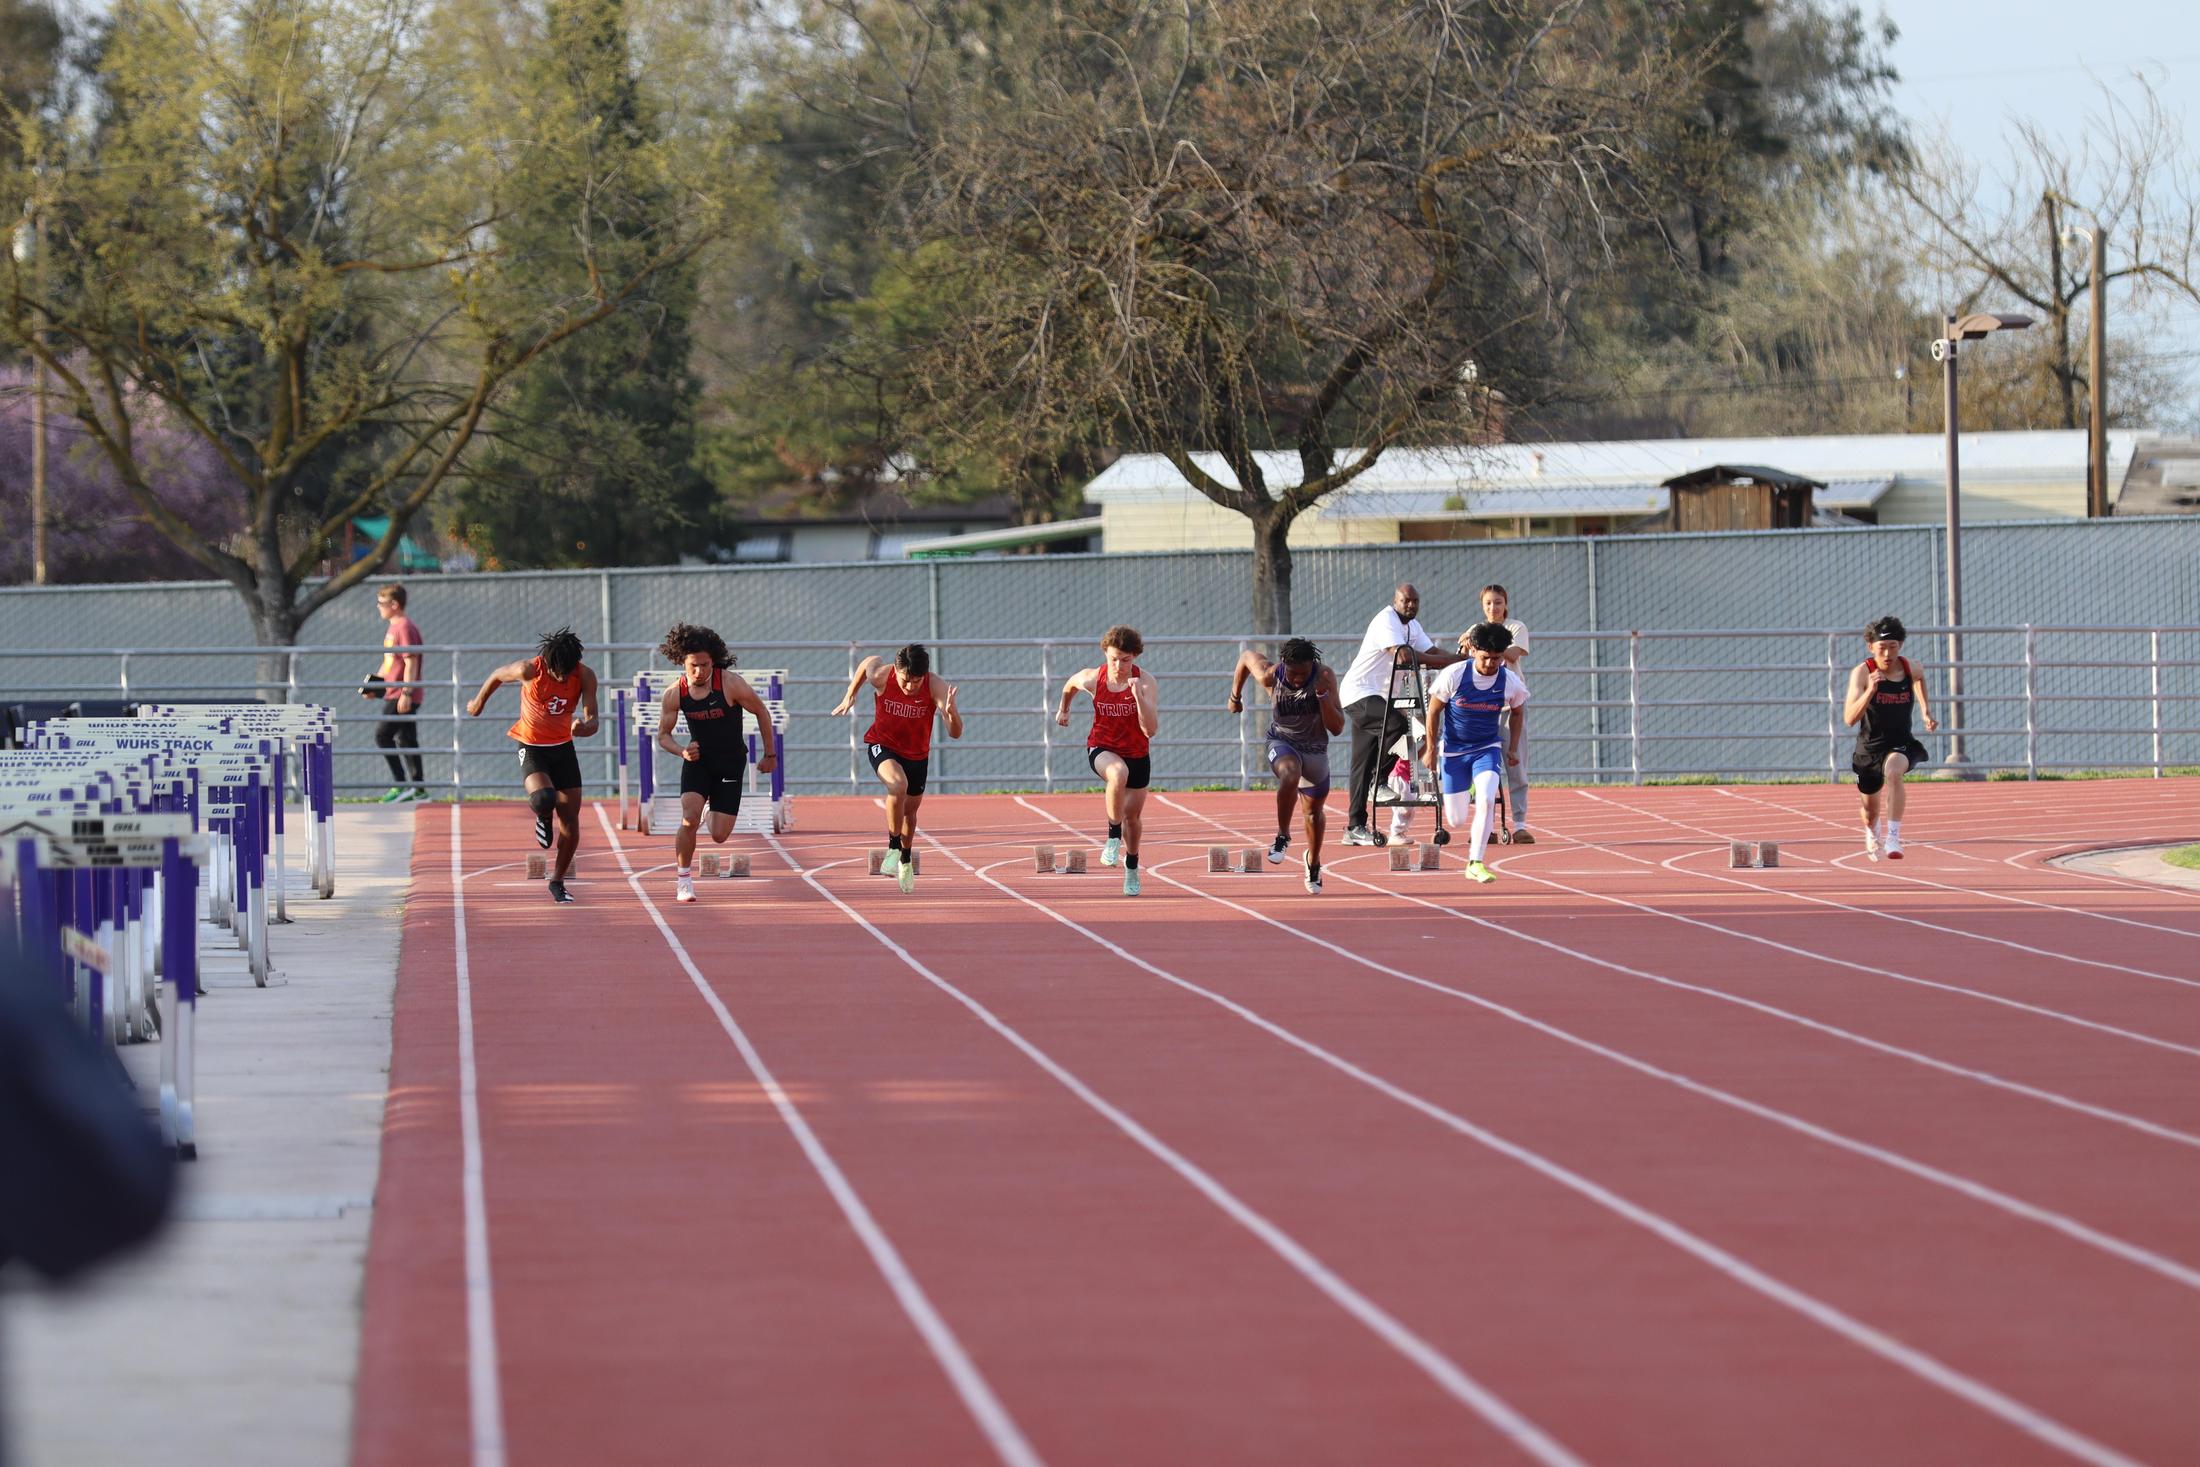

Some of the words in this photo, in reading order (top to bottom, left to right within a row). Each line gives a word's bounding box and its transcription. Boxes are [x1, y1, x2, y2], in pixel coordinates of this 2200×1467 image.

[884, 699, 928, 719] TRIBE
[1393, 699, 1416, 709] GILL
[116, 739, 160, 750] WUHS
[164, 740, 213, 751] TRACK
[233, 742, 254, 750] GILL
[223, 774, 243, 782] GILL
[27, 793, 52, 801] GILL
[113, 822, 142, 832] GILL
